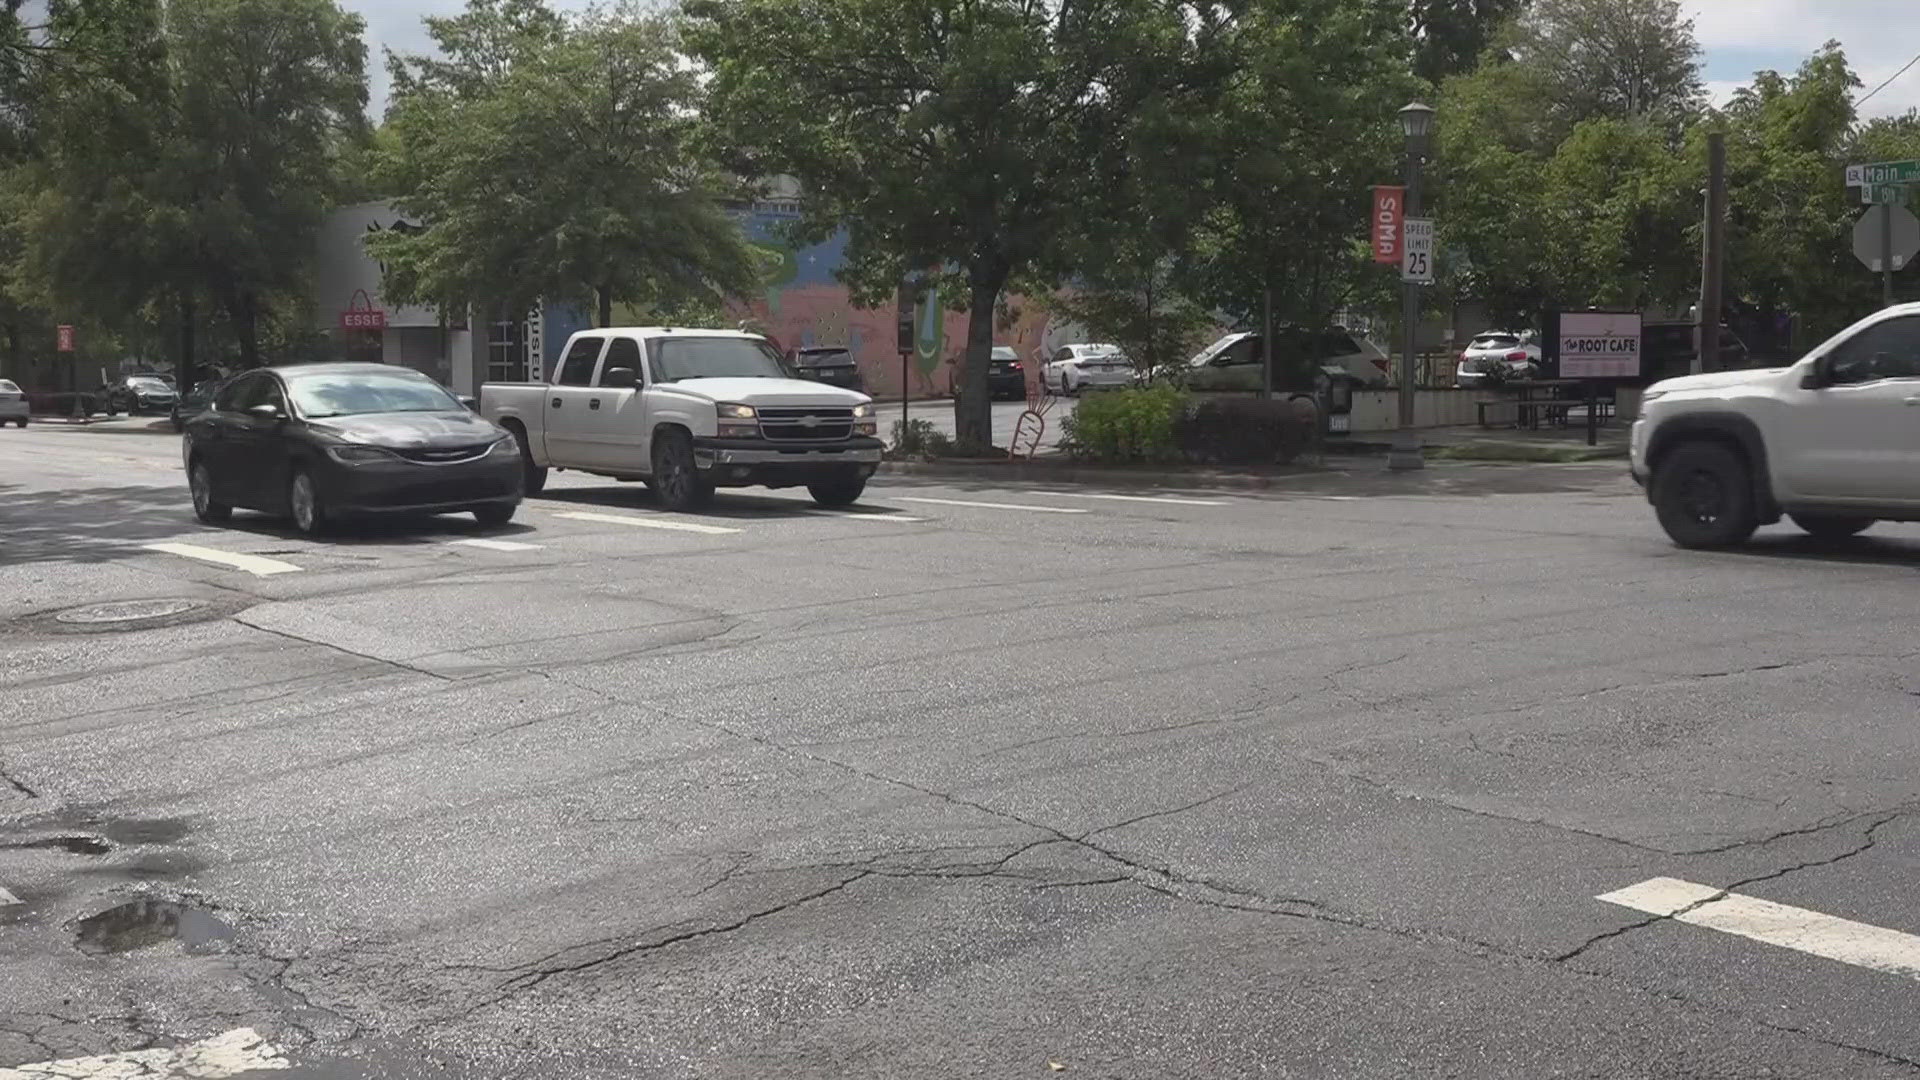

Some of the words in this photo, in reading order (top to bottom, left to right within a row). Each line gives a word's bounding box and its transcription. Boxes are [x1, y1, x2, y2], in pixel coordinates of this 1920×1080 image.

[1865, 165, 1898, 182] Main
[1406, 224, 1431, 235] SPEED
[1407, 240, 1429, 249] LIMIT
[1409, 253, 1427, 275] 25
[345, 315, 381, 326] ESSE
[1564, 338, 1577, 351] The
[1579, 340, 1607, 352] ROOT
[1610, 339, 1635, 352] CAFE
